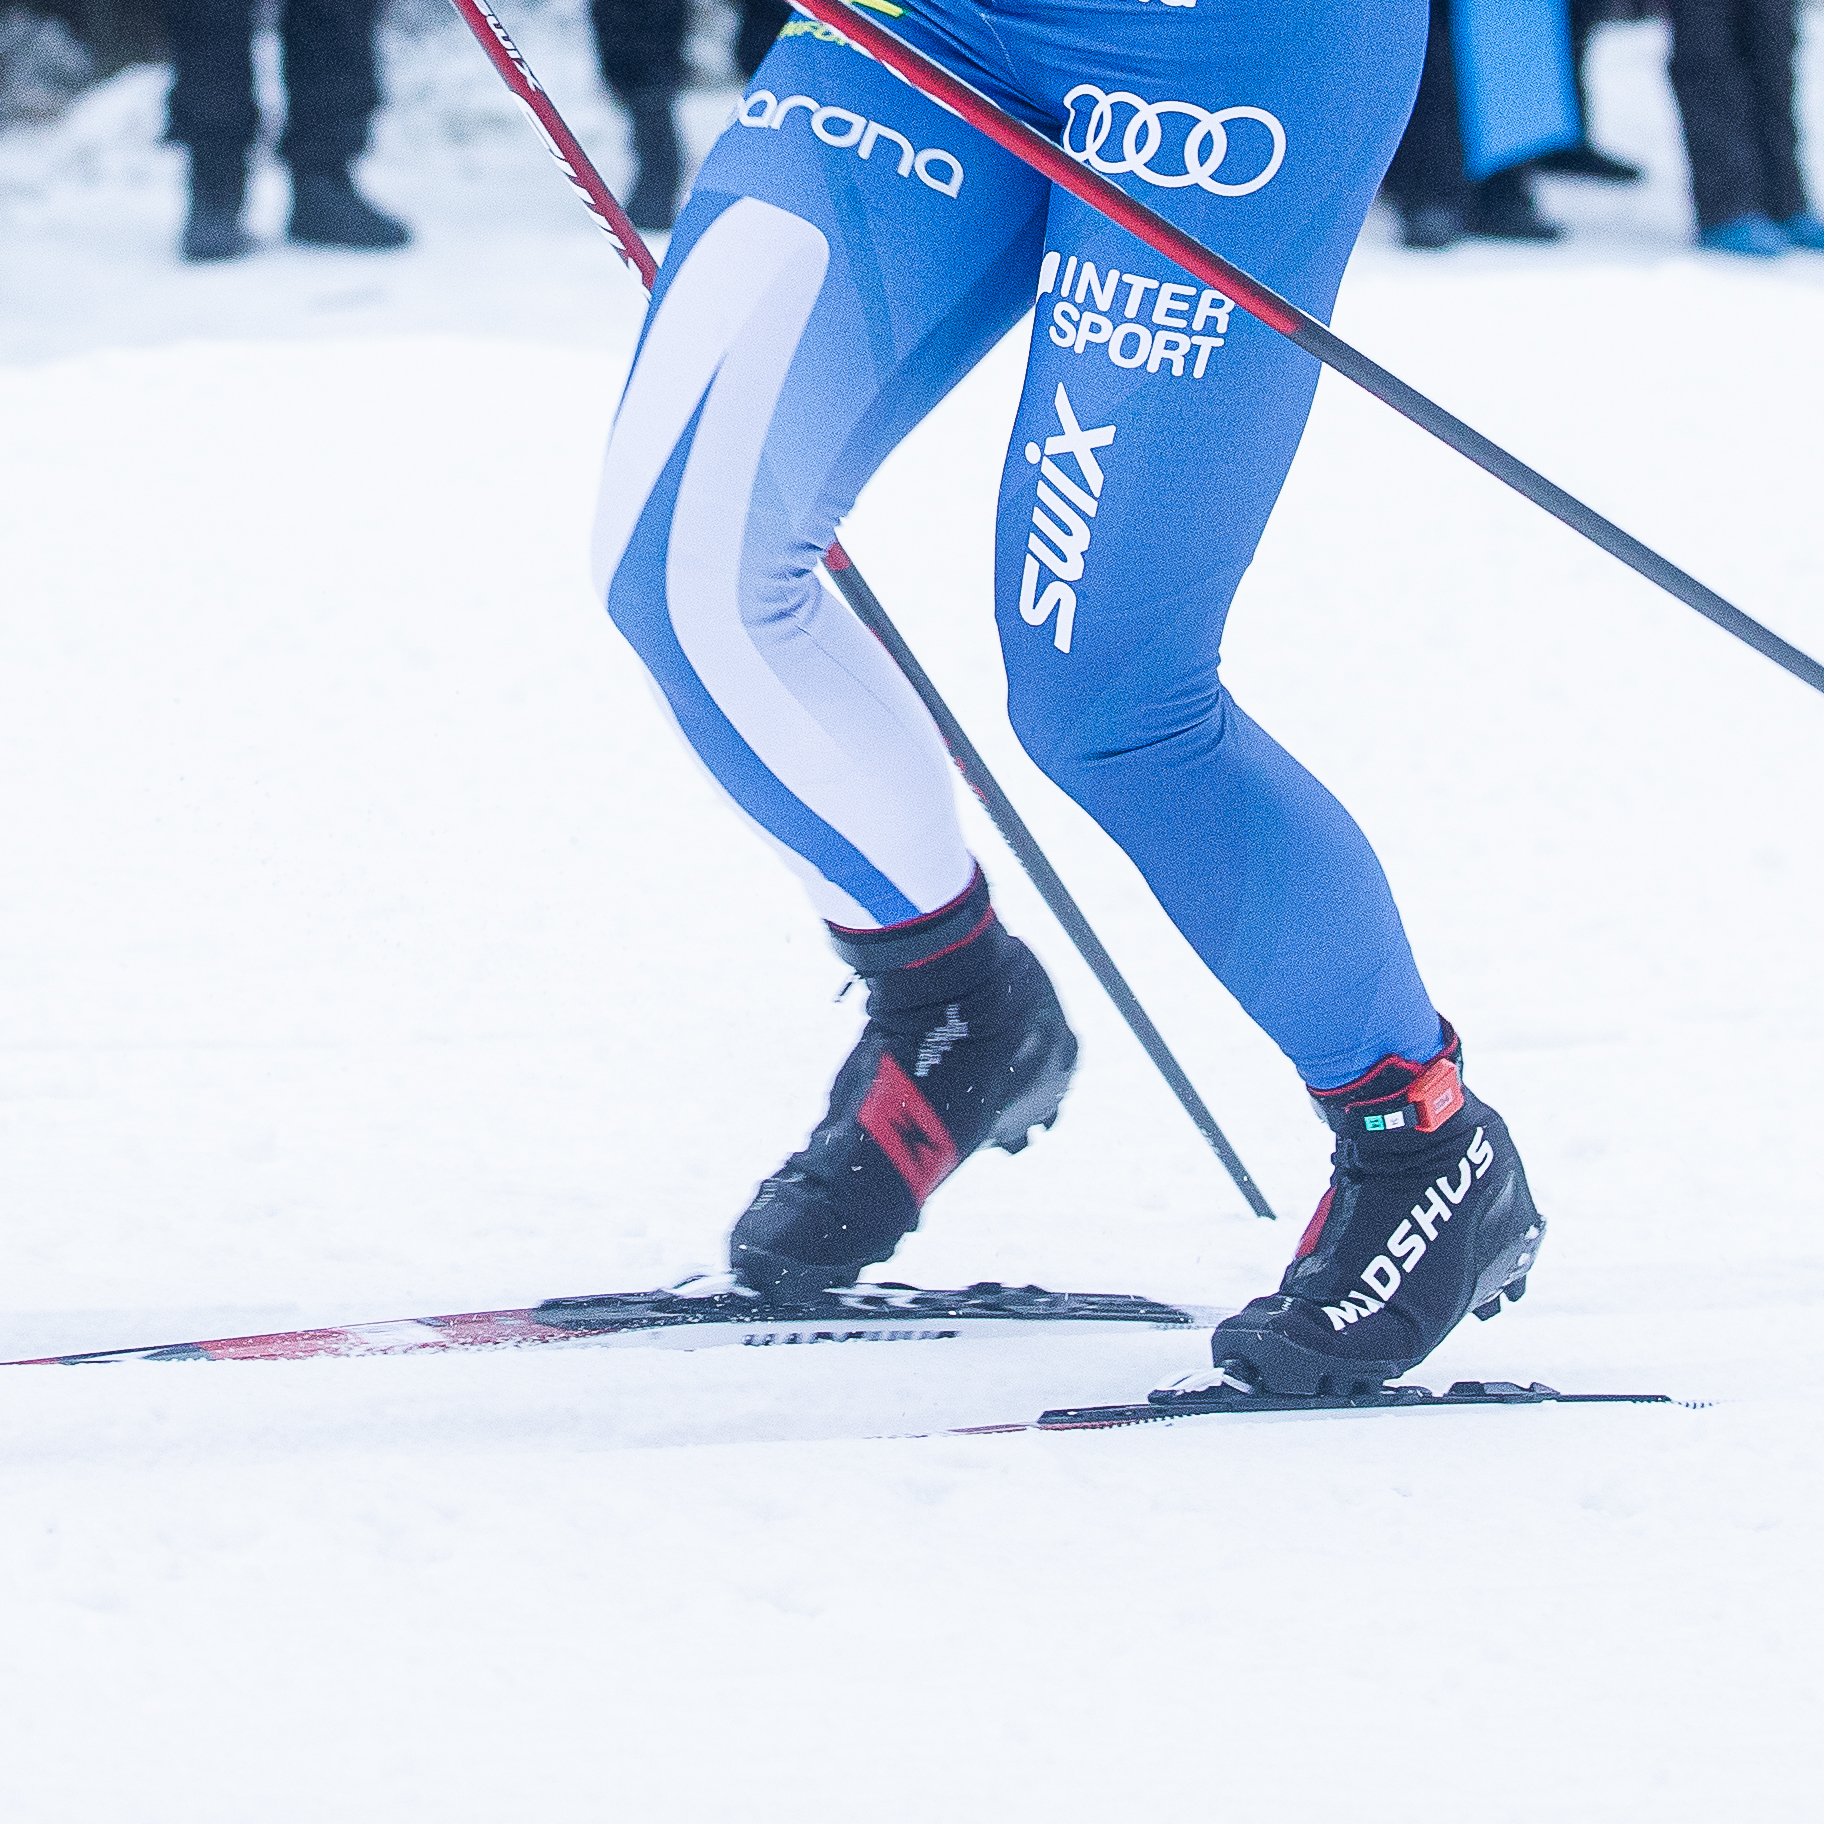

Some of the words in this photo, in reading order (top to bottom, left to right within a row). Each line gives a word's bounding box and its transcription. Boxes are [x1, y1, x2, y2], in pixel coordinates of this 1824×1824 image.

[737, 89, 965, 200] arona
[1061, 255, 1236, 334] INTER
[1049, 302, 1225, 379] SPORT
